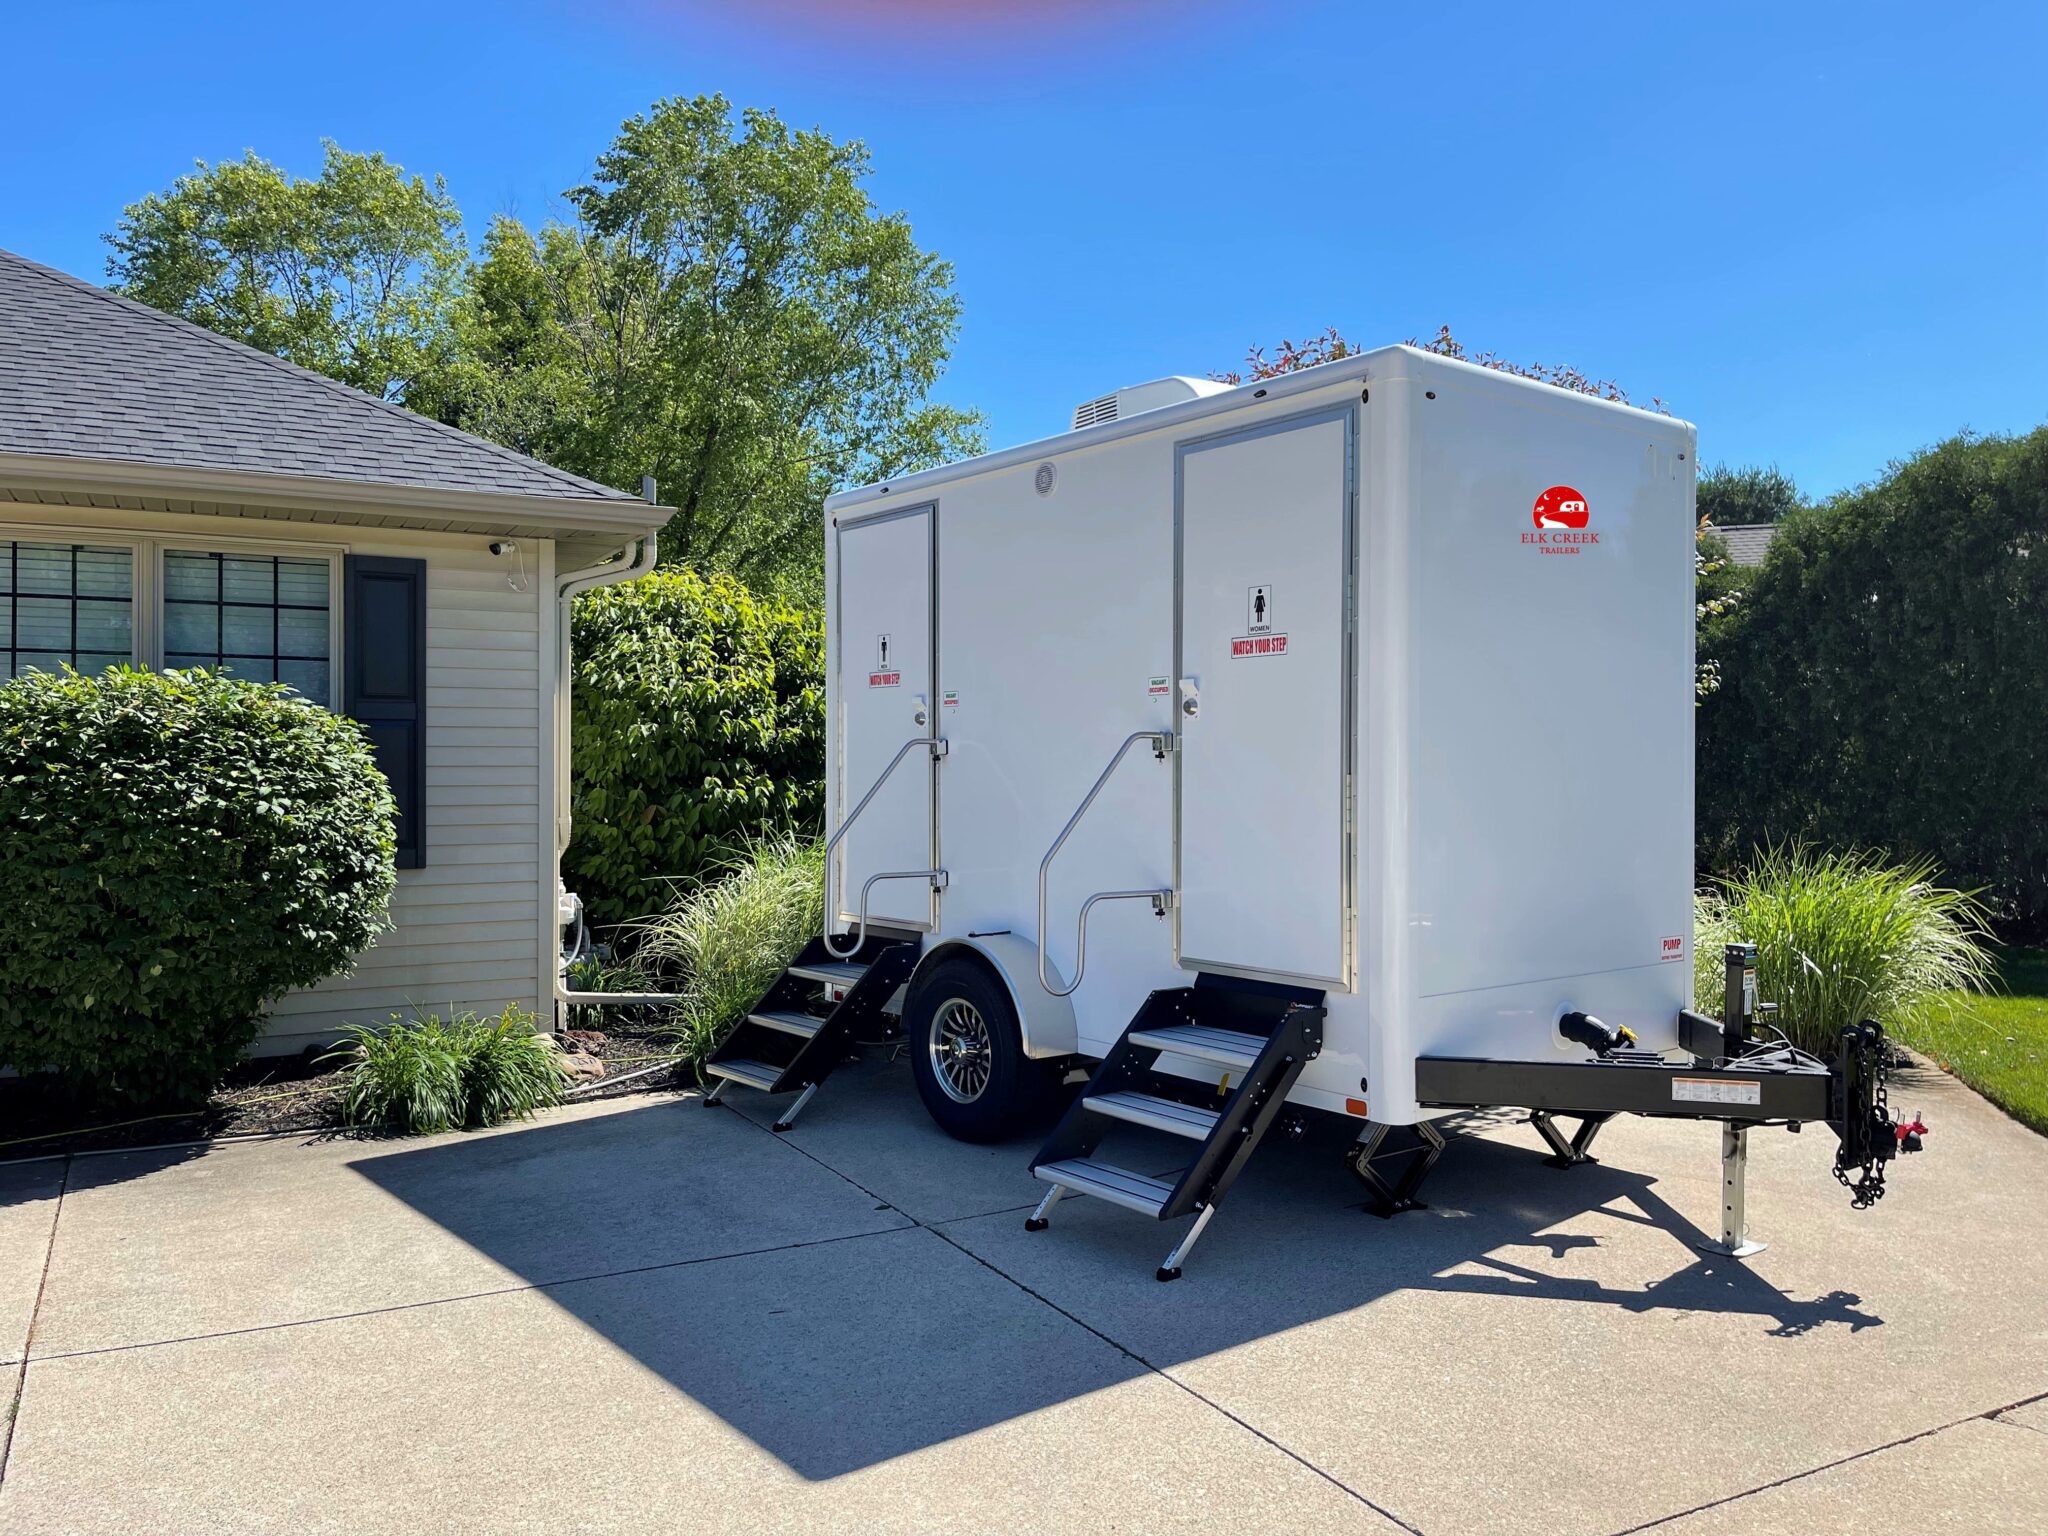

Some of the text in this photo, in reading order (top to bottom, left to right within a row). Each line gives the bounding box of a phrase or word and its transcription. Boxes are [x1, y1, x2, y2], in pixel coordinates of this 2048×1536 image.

[1521, 533, 1600, 543] ELK CREEK
[1232, 636, 1287, 655] WATCH YOUR STEP
[1663, 938, 1681, 951] PUMP
